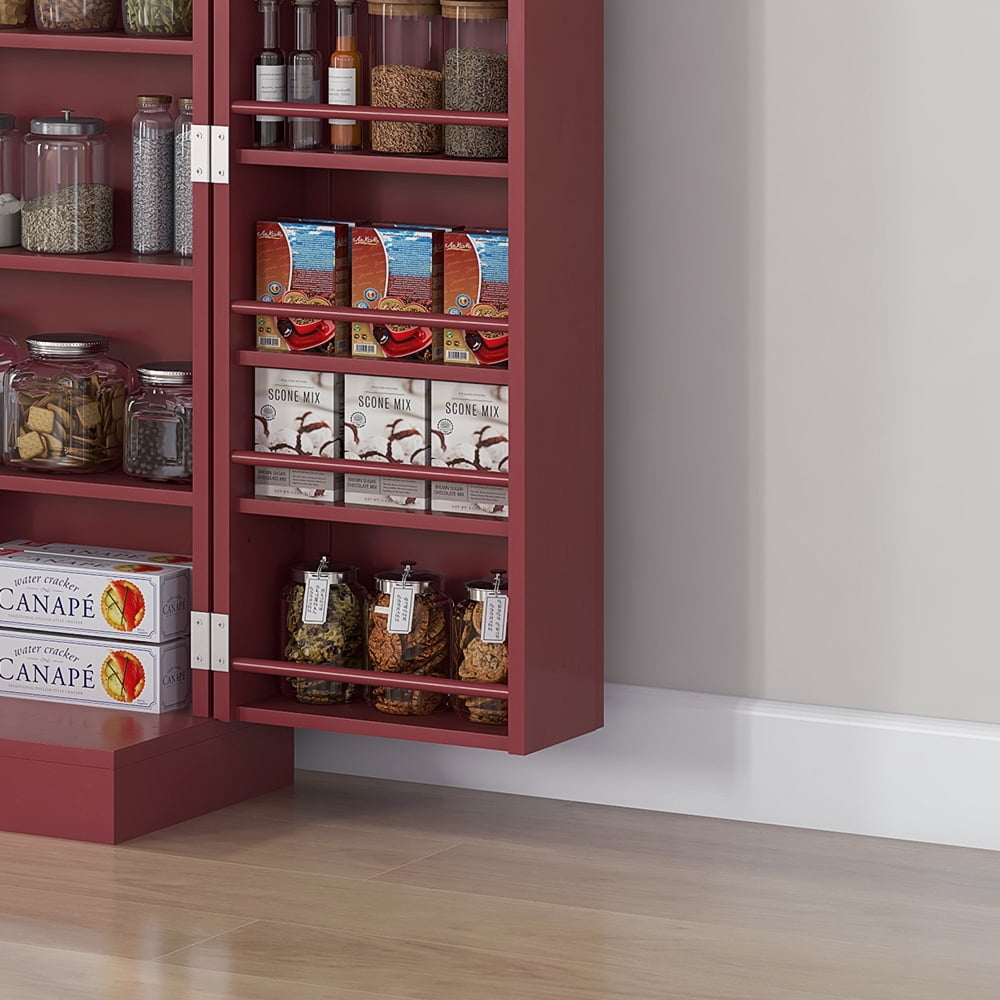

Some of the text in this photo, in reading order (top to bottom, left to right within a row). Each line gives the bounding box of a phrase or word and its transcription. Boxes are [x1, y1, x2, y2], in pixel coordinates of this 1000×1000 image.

[268, 388, 321, 404] SCONE MIX
[358, 395, 411, 411] SCONE MIX
[445, 402, 500, 418] SCONE MIX
[14, 575, 80, 592] water cracker
[14, 645, 80, 662] water cracker
